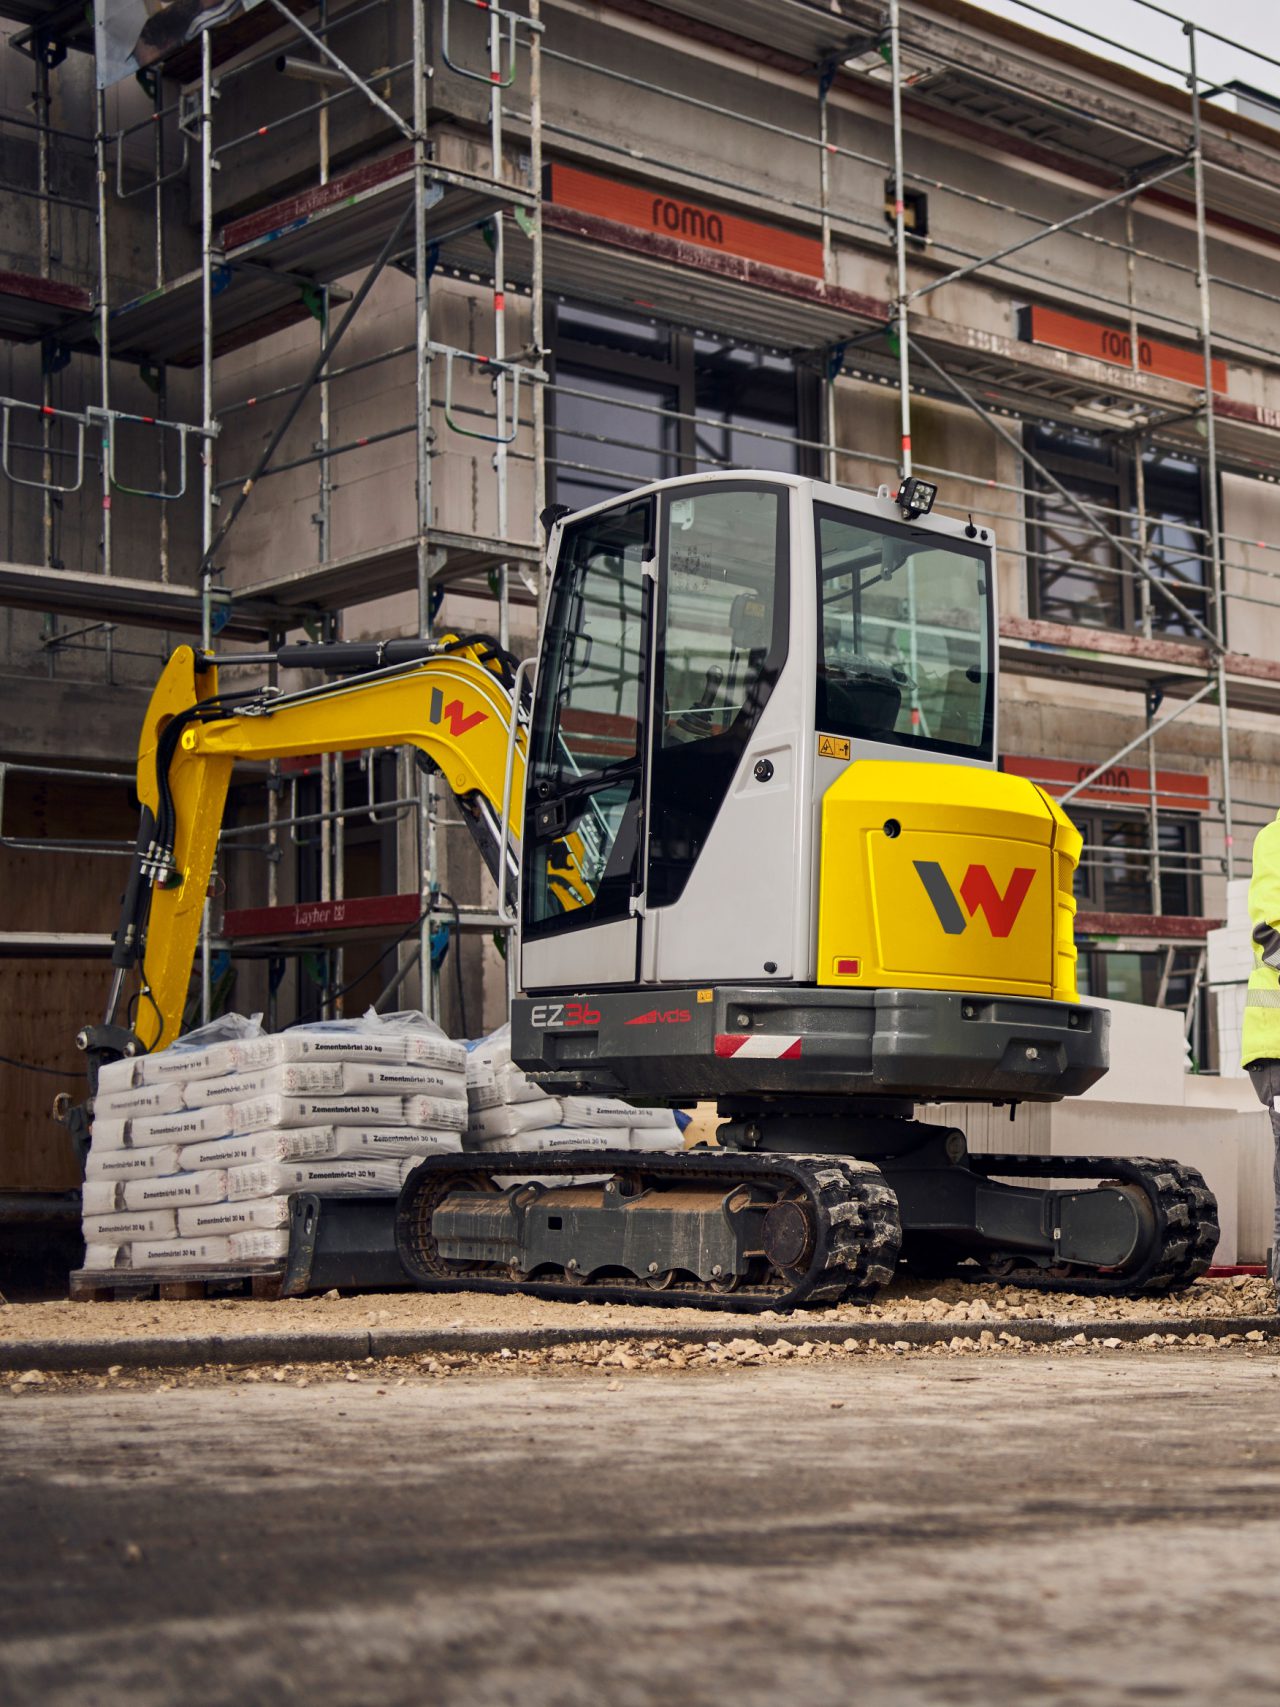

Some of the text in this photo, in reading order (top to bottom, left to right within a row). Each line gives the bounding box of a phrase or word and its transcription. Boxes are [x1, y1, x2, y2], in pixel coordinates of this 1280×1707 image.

[652, 198, 724, 245] roma
[294, 908, 331, 927] Layher
[531, 1002, 602, 1028] EZ36
